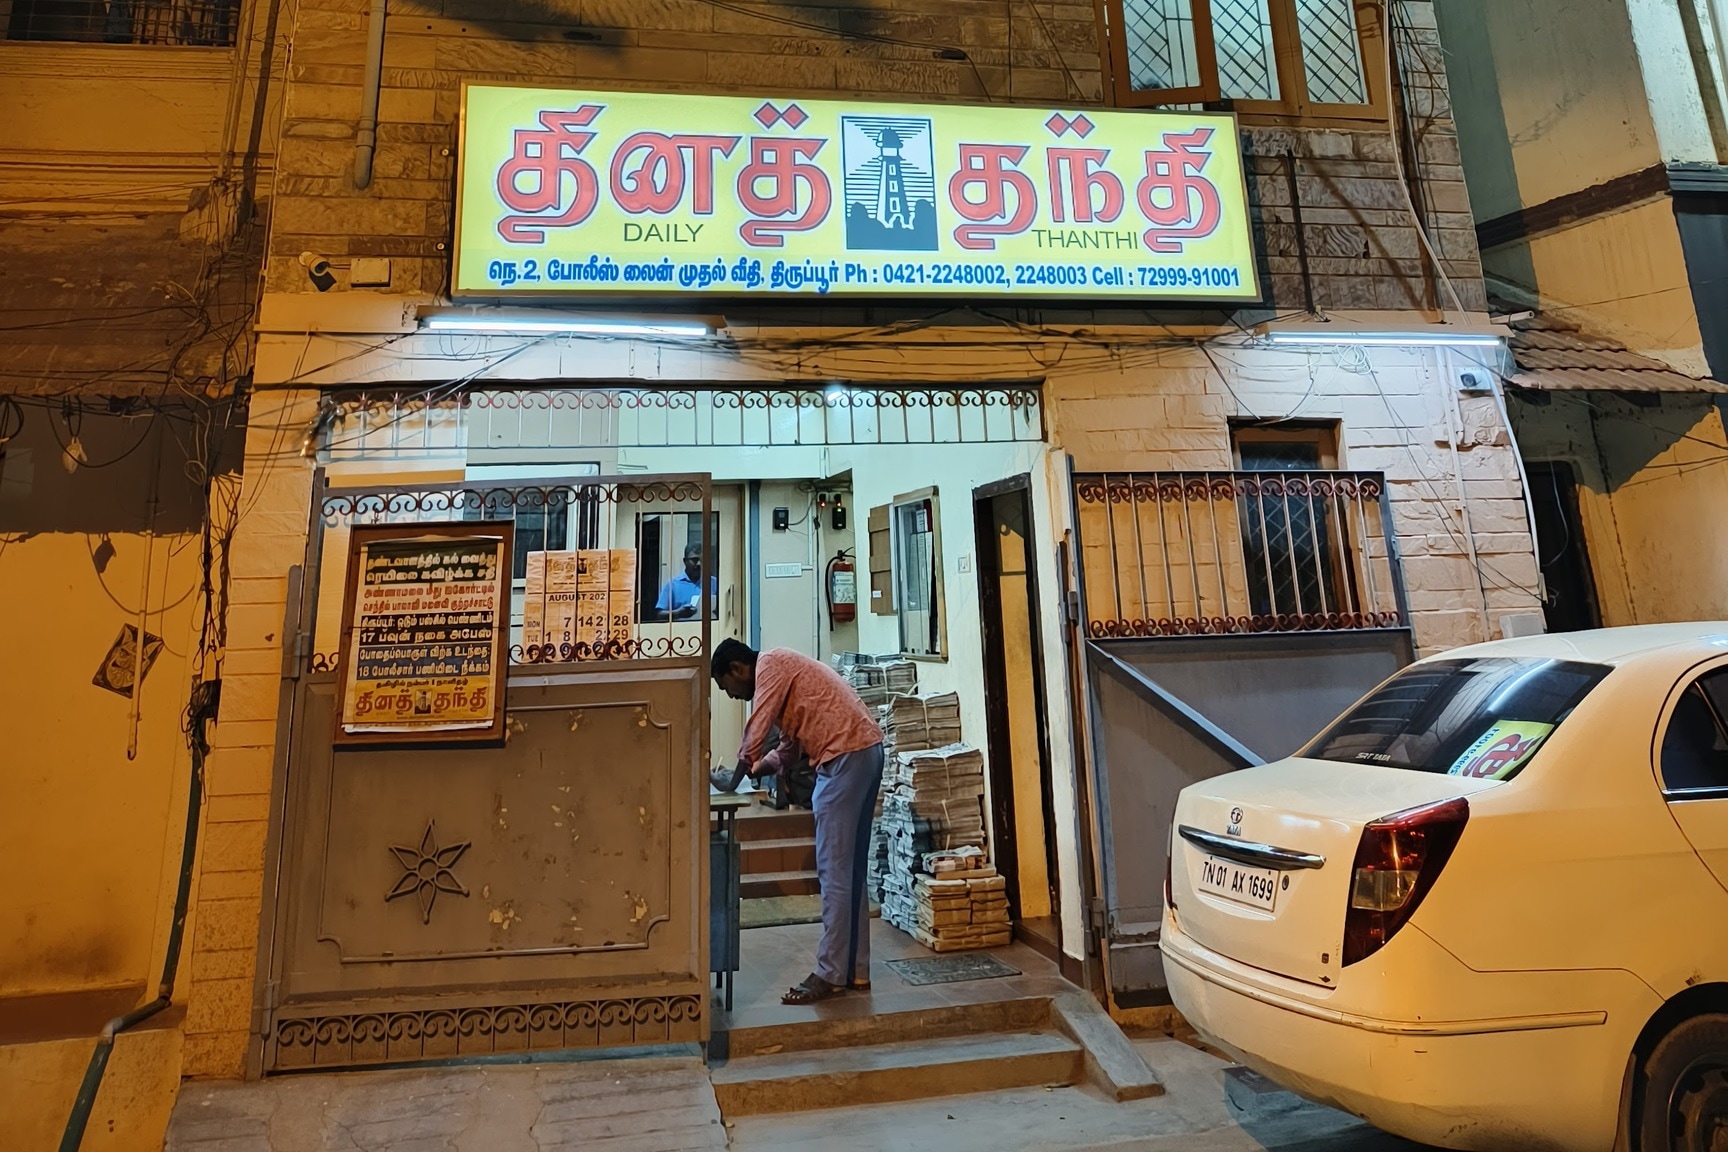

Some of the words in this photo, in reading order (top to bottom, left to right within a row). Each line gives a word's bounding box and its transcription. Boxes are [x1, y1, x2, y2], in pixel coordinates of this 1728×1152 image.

[496, 101, 832, 248] தினத்
[949, 112, 1221, 254] தந்தி
[624, 223, 704, 243] DAILY
[1031, 229, 1139, 250] THANTHI
[547, 255, 620, 282] போலீஸ்
[623, 257, 675, 282] லைன்
[679, 258, 727, 288] முதல்
[731, 256, 765, 289] வீதி,
[771, 259, 839, 294] திருப்பூர்
[845, 263, 868, 284] Ph
[883, 264, 1011, 288] 0421-2248002,
[1015, 265, 1088, 286] 2248003
[1092, 266, 1124, 286] Cell
[1137, 267, 1240, 287] 72999-91001
[563, 617, 572, 628] 7
[578, 615, 594, 627] 14
[613, 614, 629, 626] 28
[361, 632, 376, 643] 17
[563, 630, 571, 642] 8
[613, 628, 629, 640] 29
[358, 666, 370, 677] 18
[1231, 870, 1247, 894] AX
[1248, 875, 1274, 902] 1699
